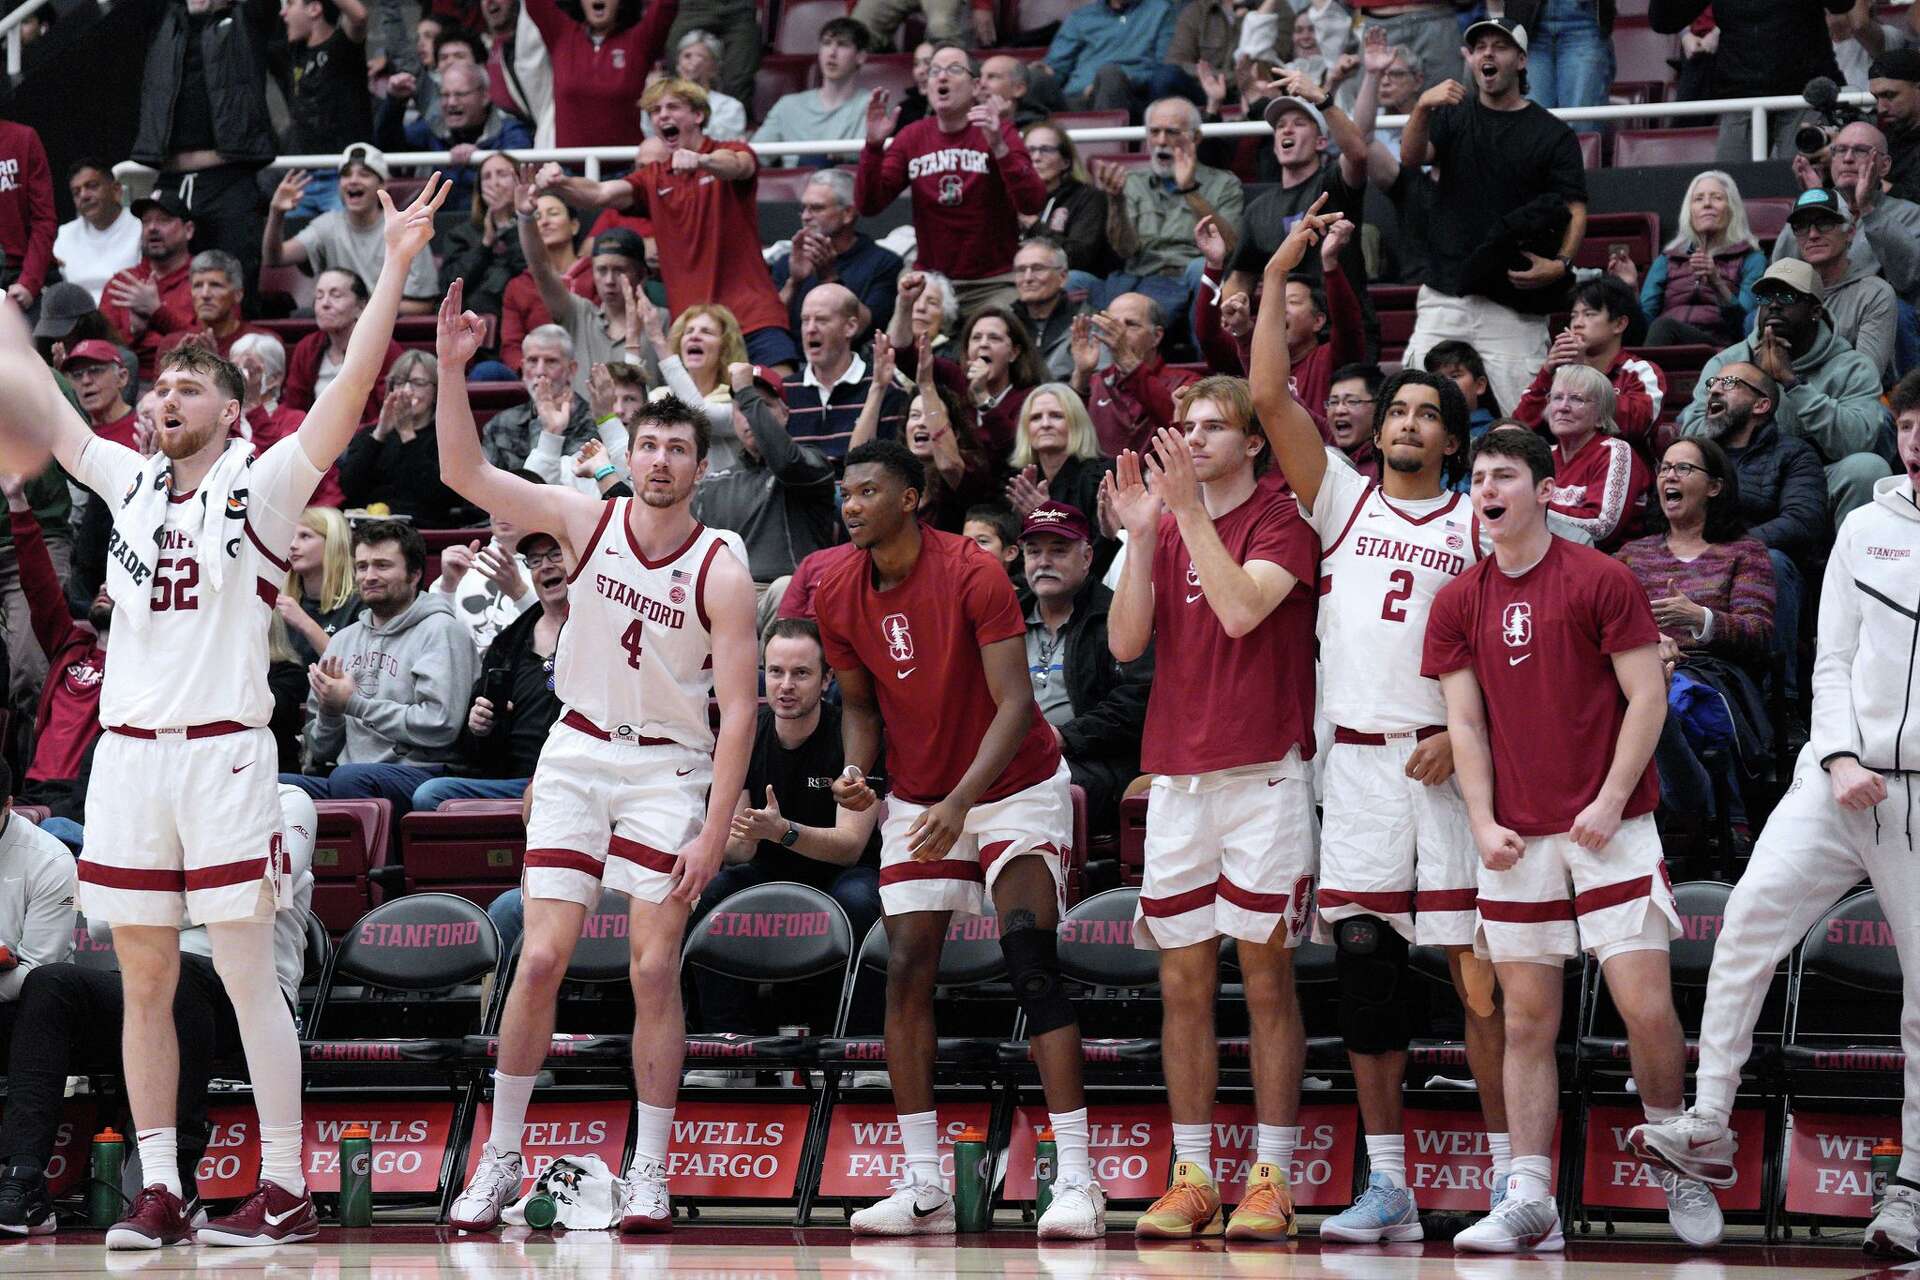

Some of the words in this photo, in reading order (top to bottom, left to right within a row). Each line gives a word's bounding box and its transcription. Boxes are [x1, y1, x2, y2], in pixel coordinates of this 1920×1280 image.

[908, 148, 990, 179] STANFOR
[1356, 536, 1465, 577] STANFORD
[1867, 546, 1911, 557] STANFORD
[150, 557, 200, 612] 52
[1381, 569, 1414, 623] 2
[597, 574, 685, 630] STANFORD
[621, 618, 643, 670] 4
[359, 920, 481, 948] STANFORD
[708, 911, 830, 938] STANFORD
[310, 1044, 403, 1061] CARDINAL
[672, 1120, 785, 1146] WELLS
[308, 1150, 422, 1174] FAGO
[666, 1152, 779, 1178] FARGO
